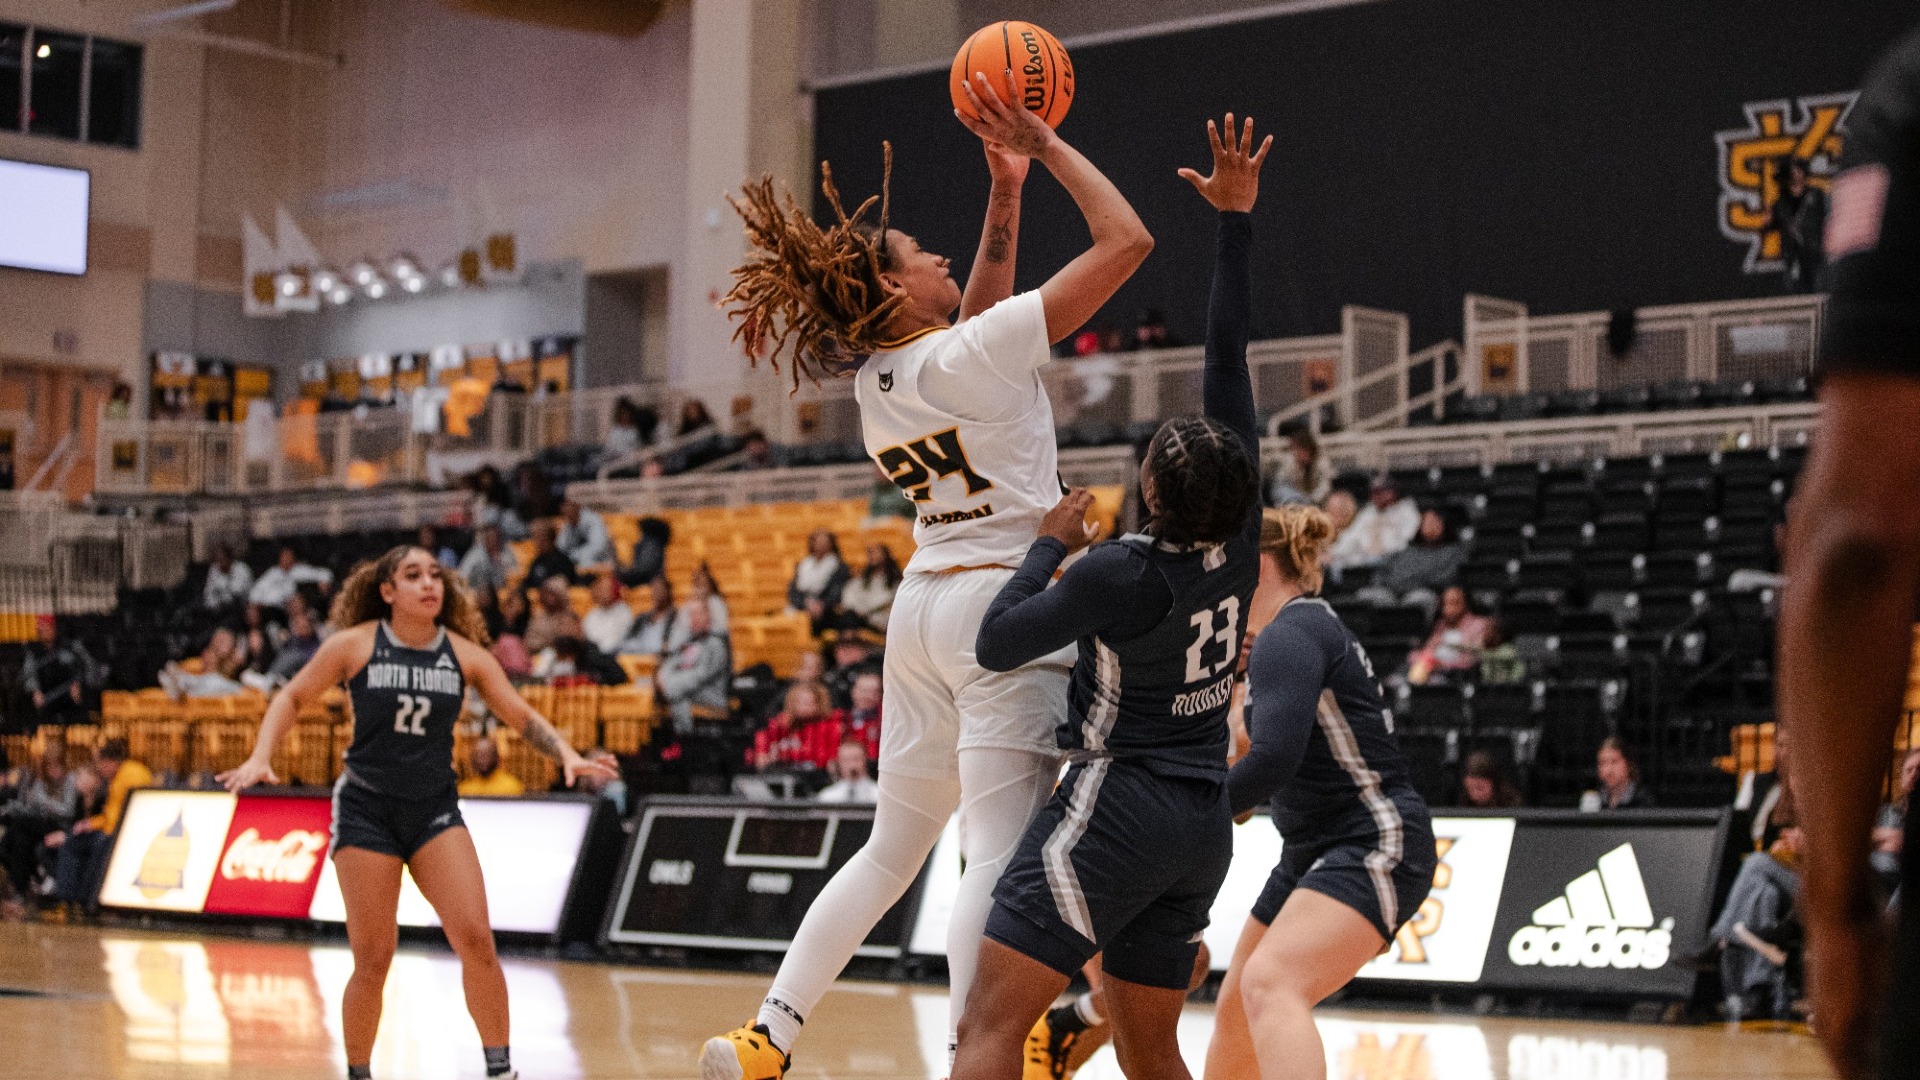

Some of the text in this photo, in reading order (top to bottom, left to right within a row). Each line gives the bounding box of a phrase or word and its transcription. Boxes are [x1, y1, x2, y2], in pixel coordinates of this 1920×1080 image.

[1021, 31, 1046, 111] Wilson
[875, 426, 994, 503] 24
[1184, 595, 1240, 684] 23
[367, 662, 409, 690] NORTH
[394, 694, 432, 737] 22
[1508, 917, 1672, 970] adidas
